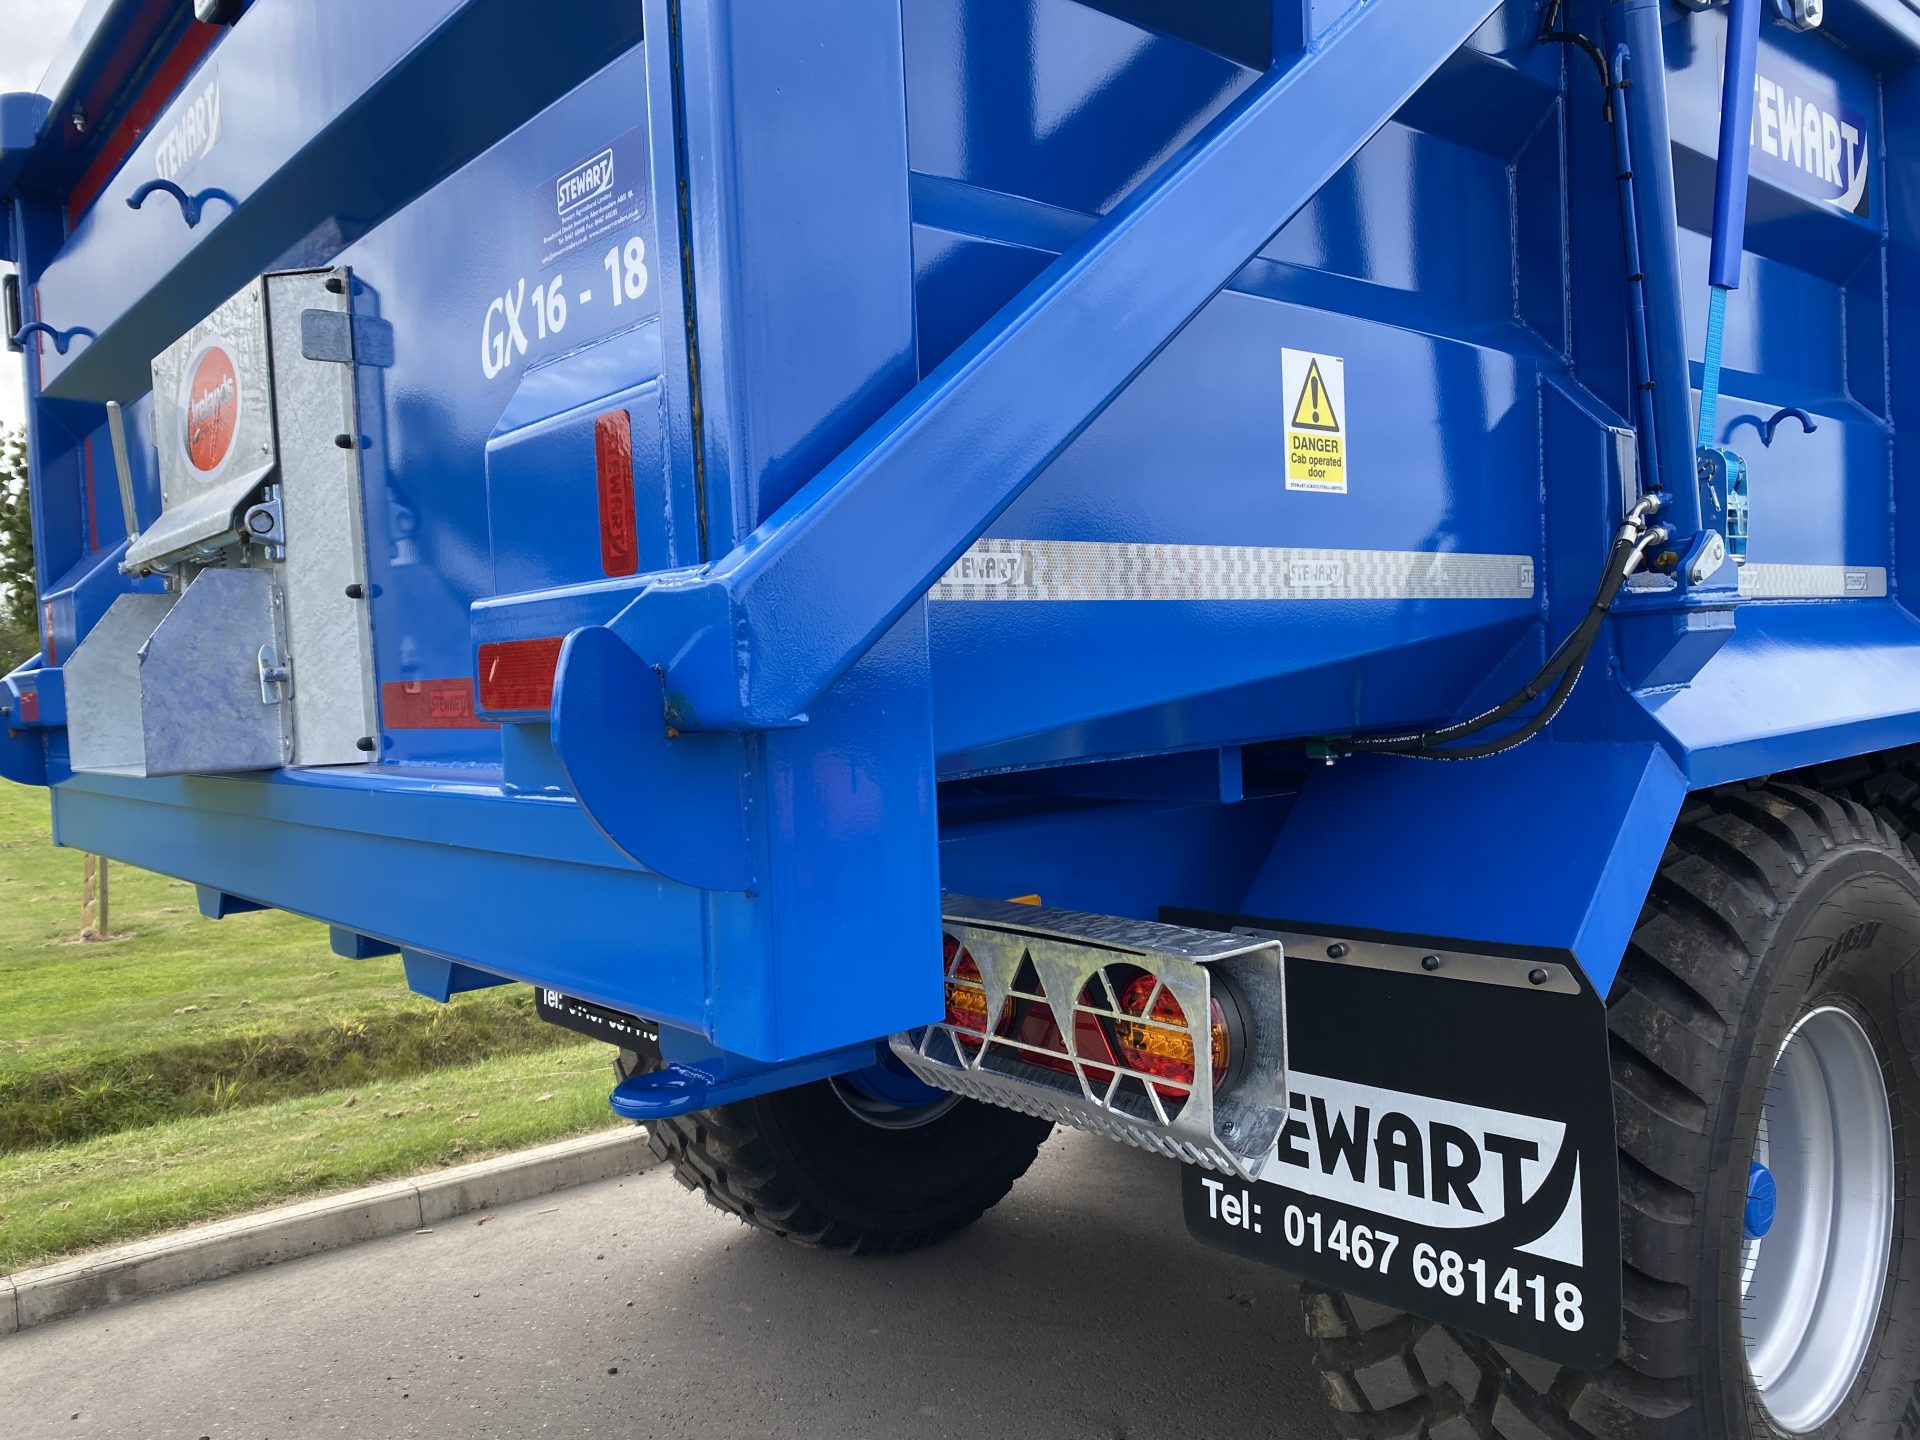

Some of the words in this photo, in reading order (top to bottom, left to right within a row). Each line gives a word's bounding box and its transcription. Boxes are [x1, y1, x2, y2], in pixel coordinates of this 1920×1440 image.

[155, 80, 220, 180] STEWART
[1750, 73, 1868, 213] EWART
[558, 156, 613, 207] STEWART
[481, 277, 528, 380] GX
[531, 273, 567, 340] 16
[604, 236, 648, 307] 18
[1291, 452, 1307, 465] Cab
[1308, 455, 1342, 468] operated
[1293, 435, 1339, 454] DANGER
[1308, 465, 1326, 479] door
[1277, 1090, 1572, 1240] EWART
[1201, 1177, 1262, 1234] Tel:
[1283, 1204, 1400, 1275] 01467
[1412, 1242, 1585, 1333] 681418
